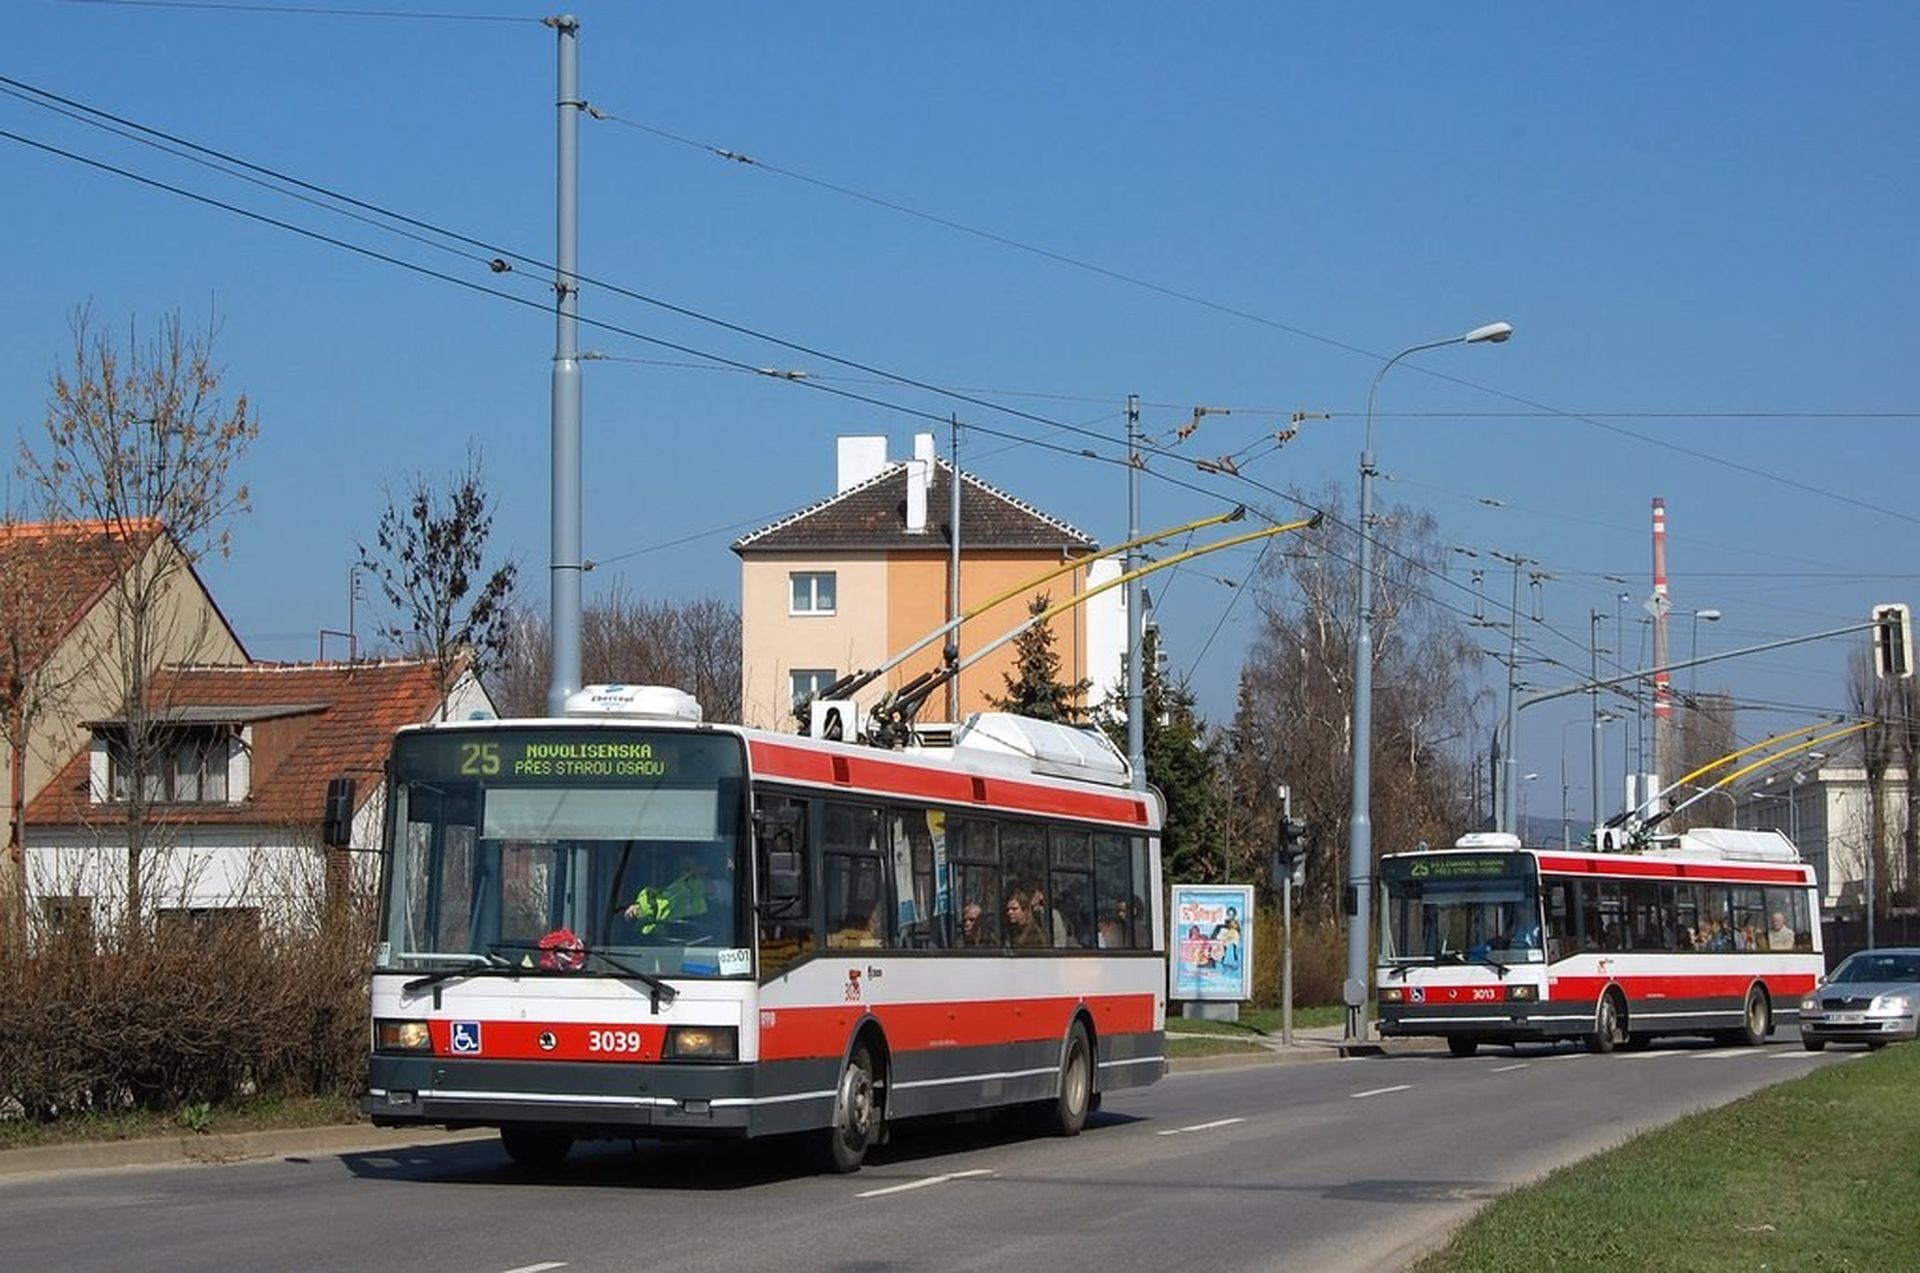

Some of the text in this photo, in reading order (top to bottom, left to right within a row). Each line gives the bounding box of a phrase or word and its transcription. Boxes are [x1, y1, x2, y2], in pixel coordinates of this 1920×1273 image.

[461, 743, 500, 775] 25
[556, 760, 612, 775] STAROU
[616, 760, 665, 775] OSADU
[588, 1030, 641, 1053] 3039
